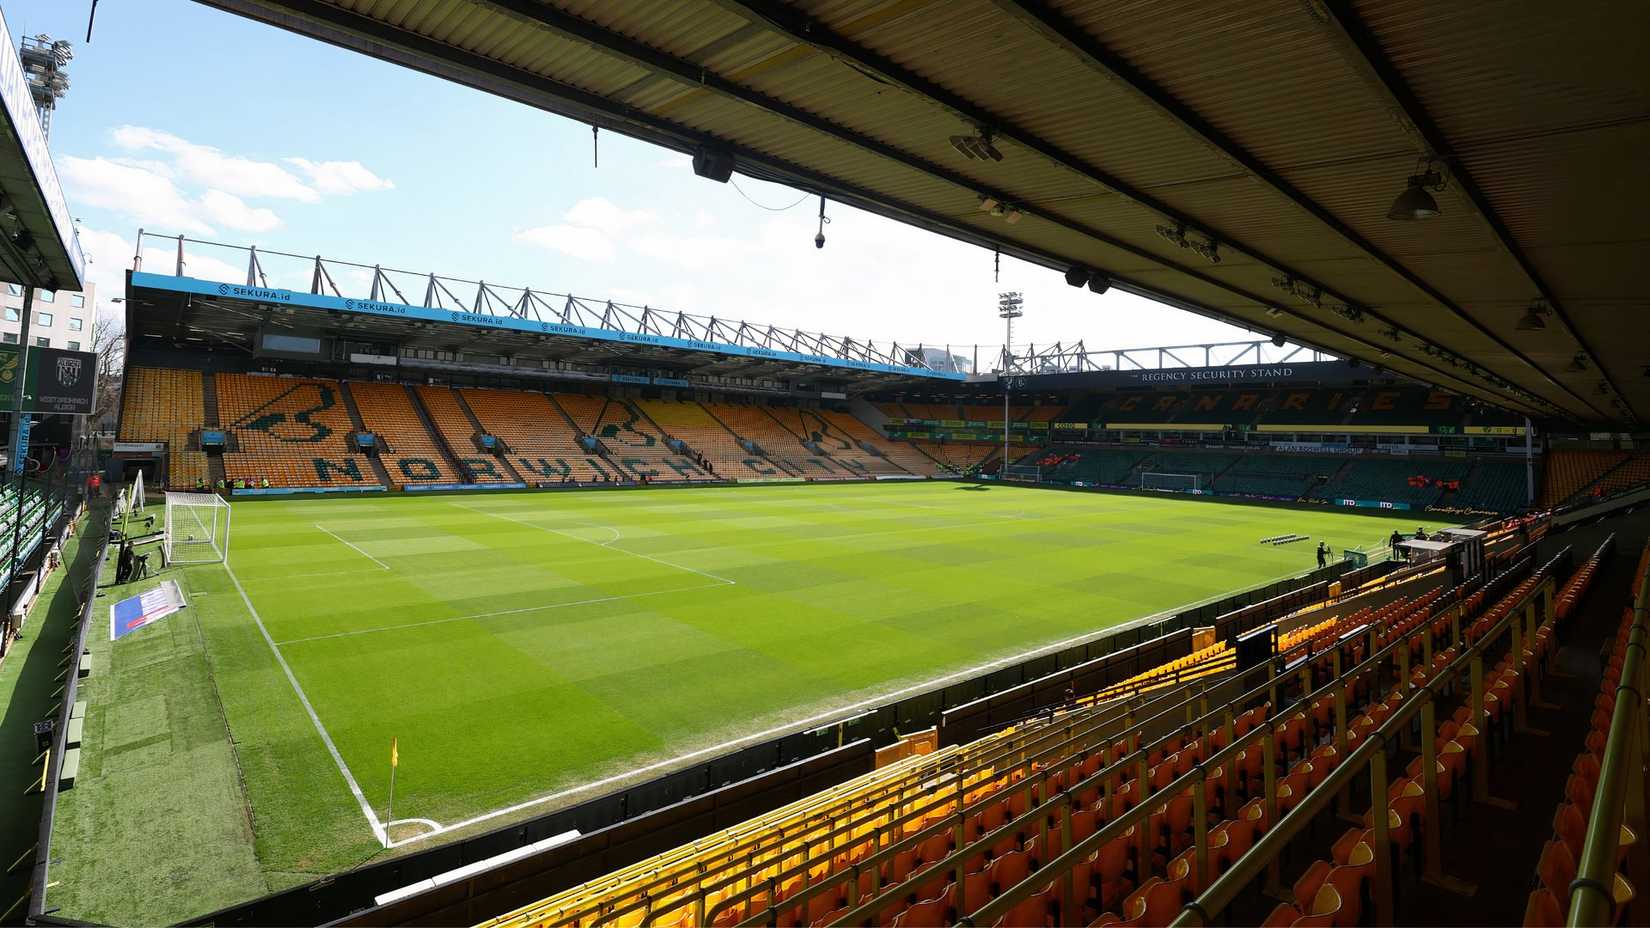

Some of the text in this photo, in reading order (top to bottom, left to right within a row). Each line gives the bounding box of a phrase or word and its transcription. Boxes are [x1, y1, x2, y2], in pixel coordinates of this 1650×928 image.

[233, 287, 291, 301] SEKURA.id
[357, 301, 406, 314] SEKURA.id
[461, 314, 503, 325] SEKURA.id
[1142, 368, 1293, 382] REGENCY SECURITY STAND
[312, 457, 704, 482] NORWICH
